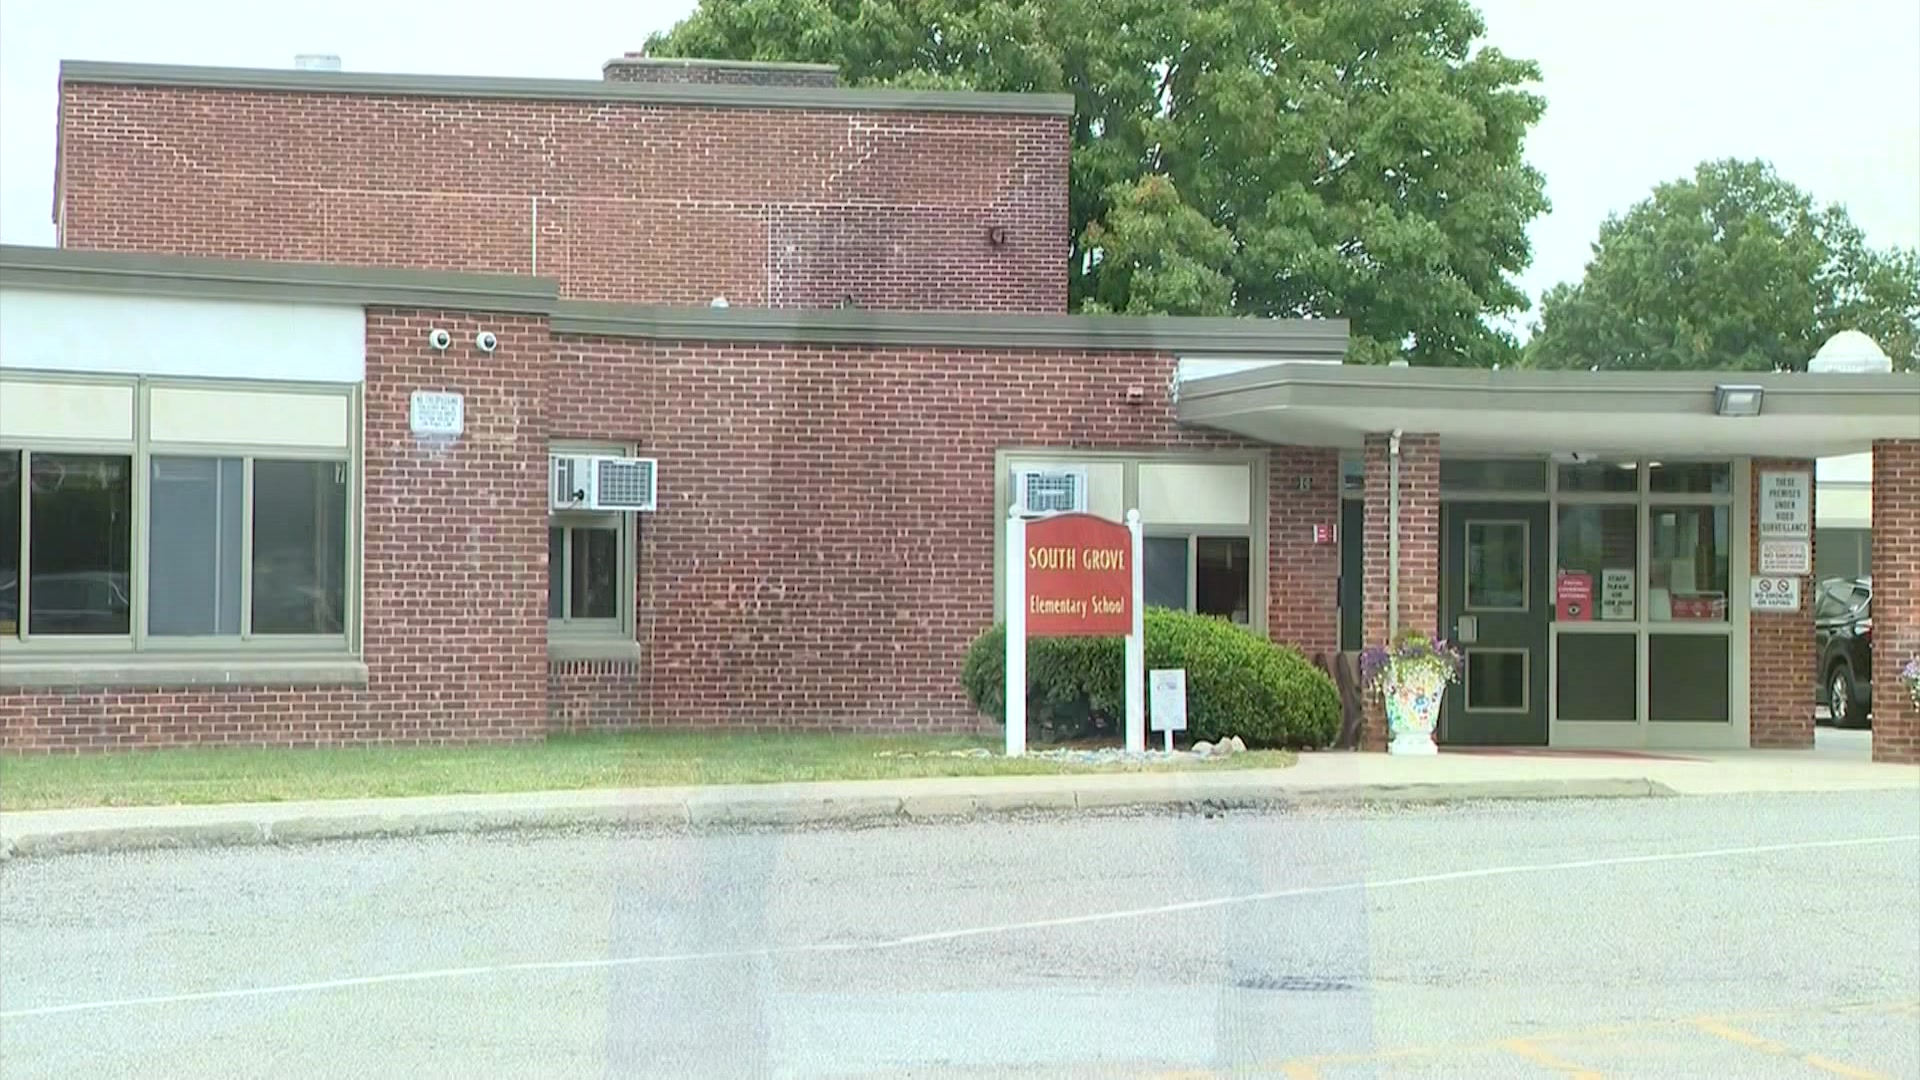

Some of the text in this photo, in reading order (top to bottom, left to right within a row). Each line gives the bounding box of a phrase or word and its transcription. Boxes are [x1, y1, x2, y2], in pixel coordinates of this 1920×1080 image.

[1775, 477, 1794, 487] THESE
[1769, 489, 1800, 498] PREMISES
[1774, 501, 1795, 510] UNDER
[1776, 512, 1794, 521] VIDEO
[1762, 523, 1807, 532] SURVEILLANCE
[1029, 547, 1125, 570] SOUTH GROVE
[1030, 594, 1125, 619] Elementary School
